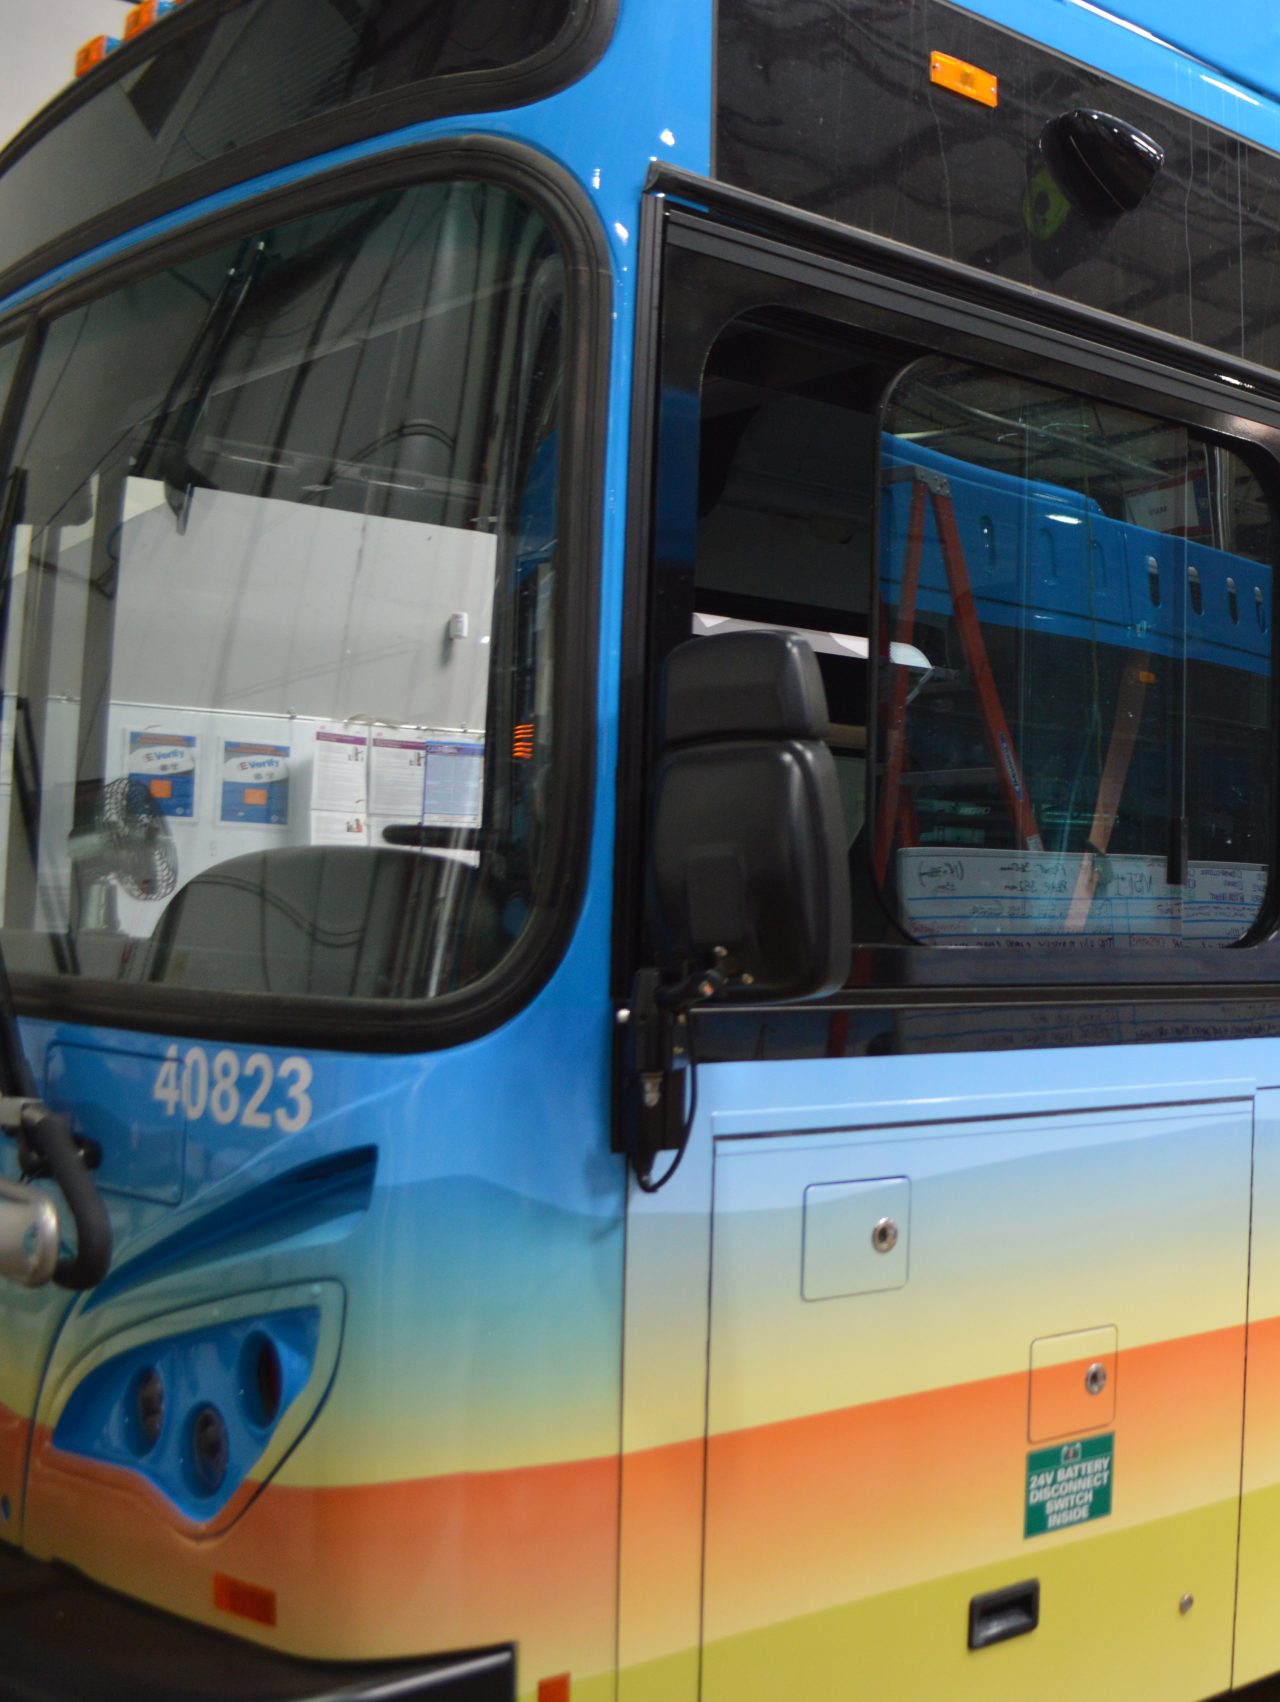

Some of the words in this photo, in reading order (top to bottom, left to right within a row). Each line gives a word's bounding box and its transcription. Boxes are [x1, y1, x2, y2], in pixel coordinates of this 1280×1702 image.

[153, 1043, 314, 1134] 40823
[1029, 1470, 1110, 1506] DISCONNECT
[1030, 1469, 1055, 1490] 24V
[1056, 1456, 1110, 1482] BATTERY
[1045, 1489, 1094, 1516] SWITCH
[1048, 1504, 1090, 1529] INSIDE
